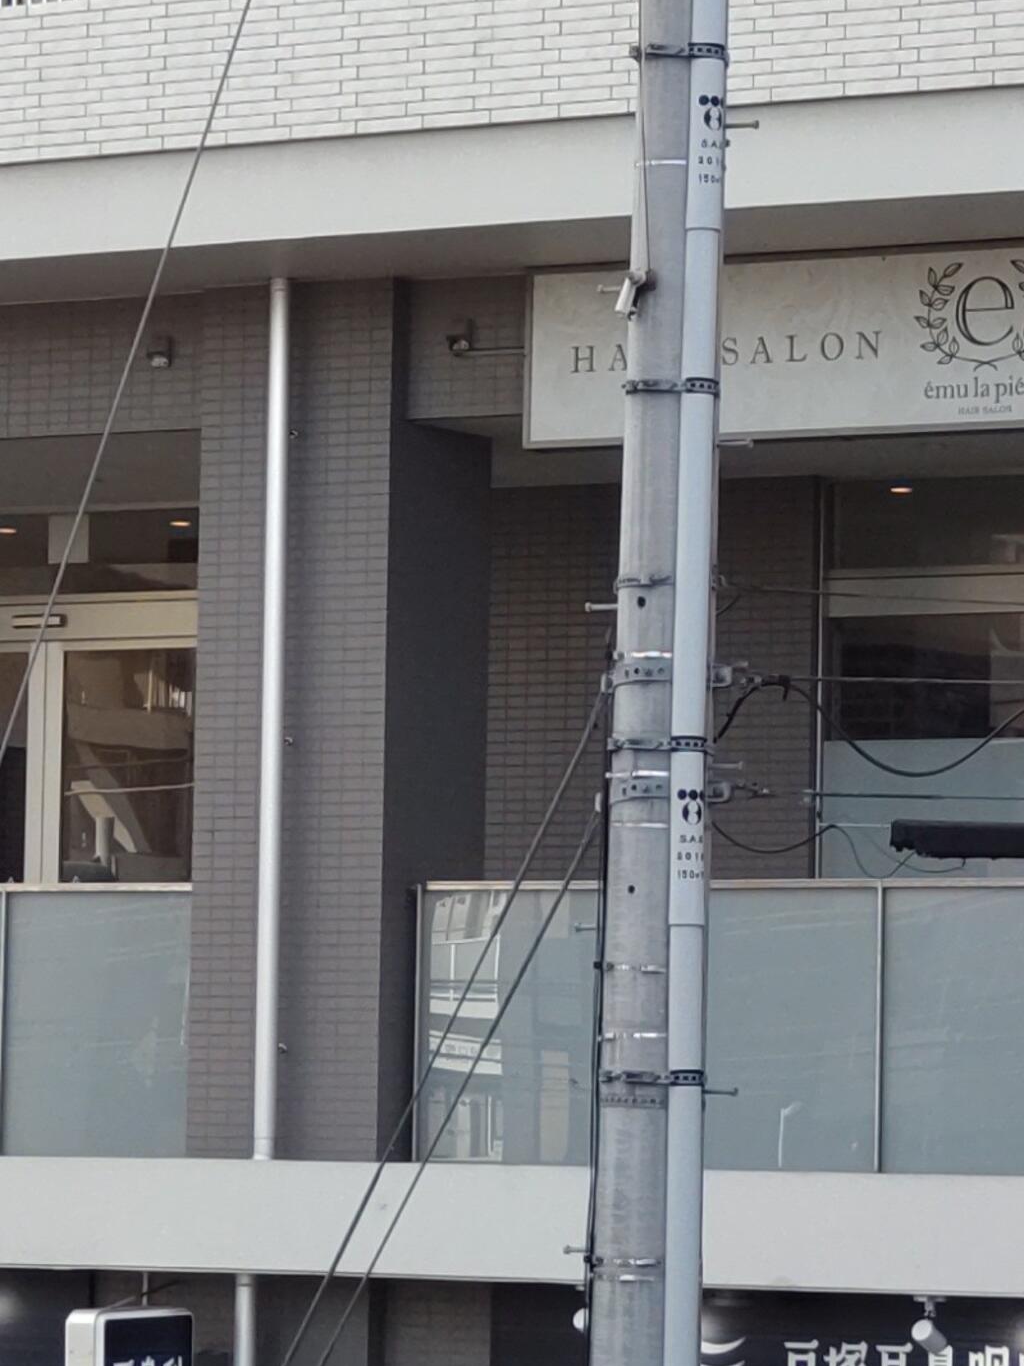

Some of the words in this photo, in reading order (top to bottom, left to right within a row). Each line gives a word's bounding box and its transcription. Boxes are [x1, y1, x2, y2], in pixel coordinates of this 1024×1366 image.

[571, 343, 628, 373] HA
[721, 330, 882, 366] SALON
[974, 376, 990, 398] la
